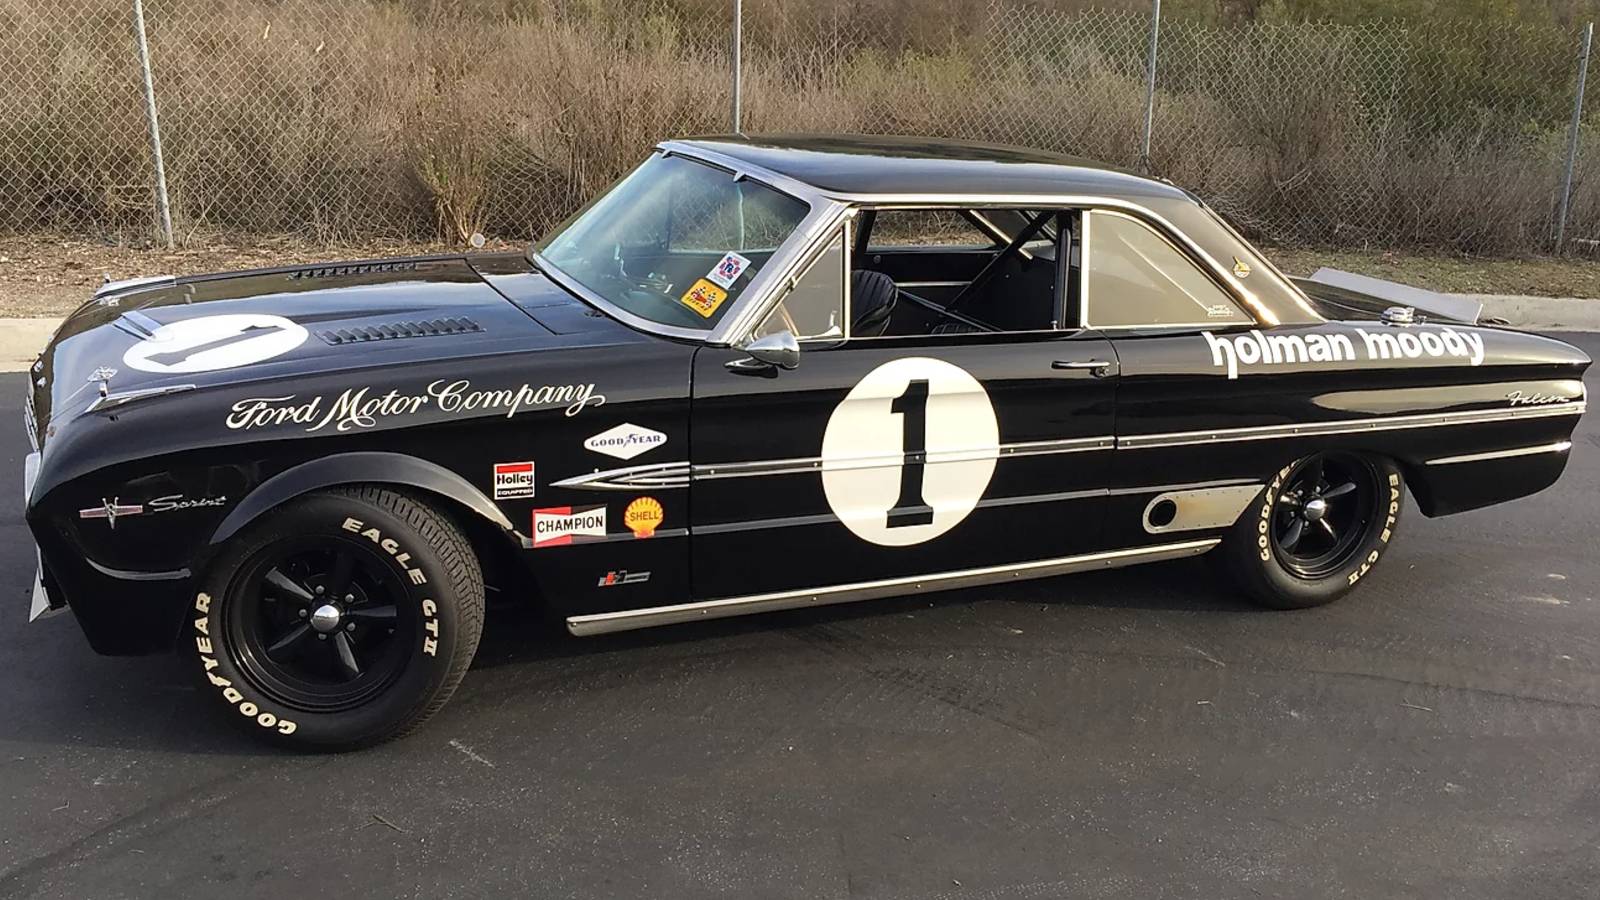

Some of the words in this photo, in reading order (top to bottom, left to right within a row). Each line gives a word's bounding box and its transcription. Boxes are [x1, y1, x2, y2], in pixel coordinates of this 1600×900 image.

[143, 325, 286, 366] 1
[1201, 330, 1356, 380] holman
[1355, 328, 1484, 367] moody
[226, 394, 322, 430] Ford
[305, 386, 428, 431] Motor
[427, 379, 606, 418] Company
[1507, 390, 1570, 406] Falcon
[591, 433, 661, 448] GOODYEAR
[886, 379, 934, 528] 1
[496, 473, 533, 486] Holley
[537, 515, 604, 533] CHAMPION
[630, 509, 659, 522] SHELL
[1380, 474, 1399, 543] EAGLE
[342, 517, 427, 586] EAGLE
[194, 592, 297, 735] GOODYEAR
